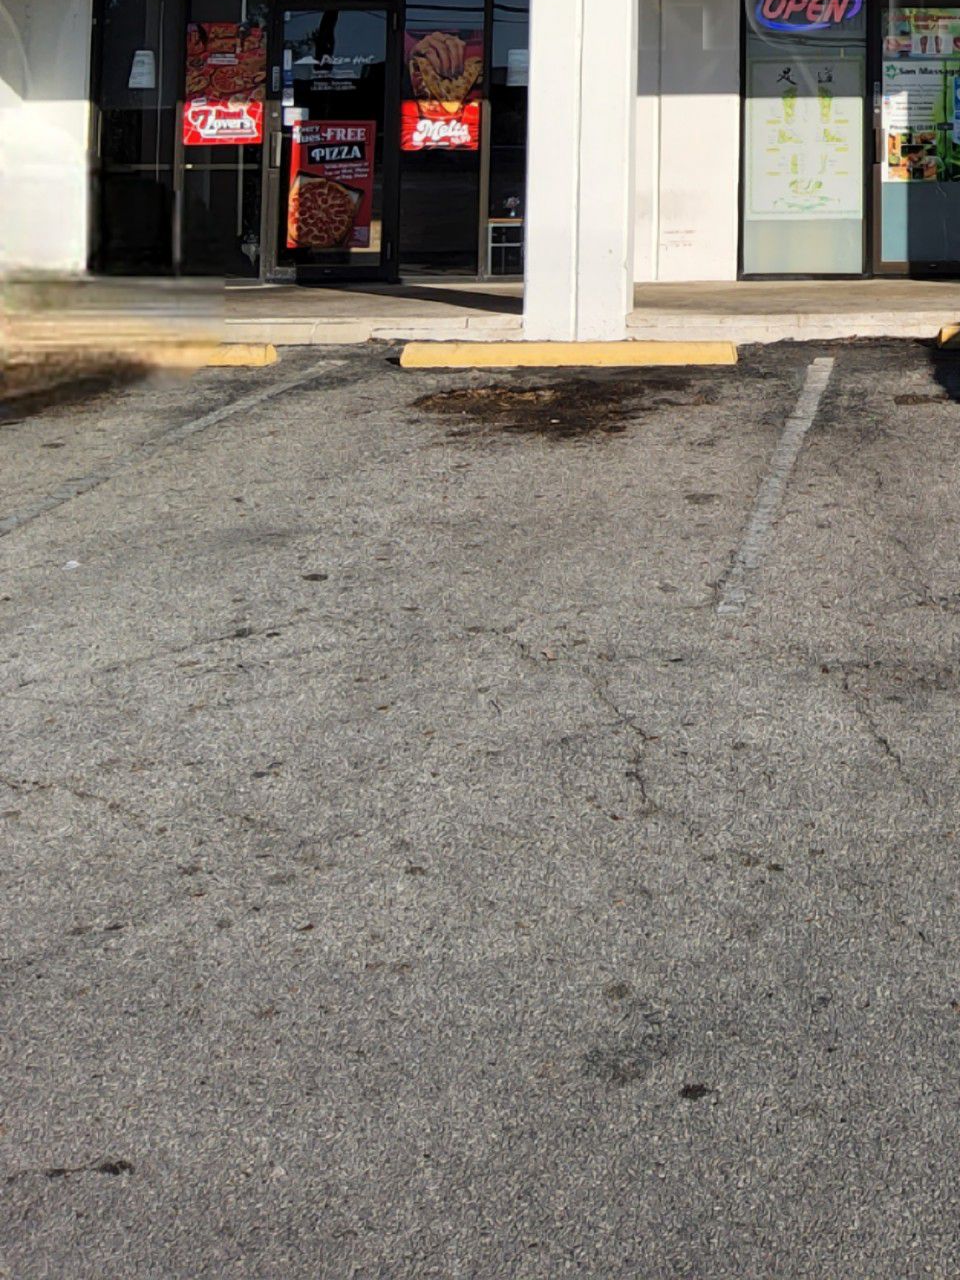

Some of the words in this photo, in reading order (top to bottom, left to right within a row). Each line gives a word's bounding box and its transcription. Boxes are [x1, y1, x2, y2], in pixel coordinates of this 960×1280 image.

[325, 127, 367, 141] FREE
[413, 119, 468, 145] Melts
[310, 144, 362, 162] PIZZA
